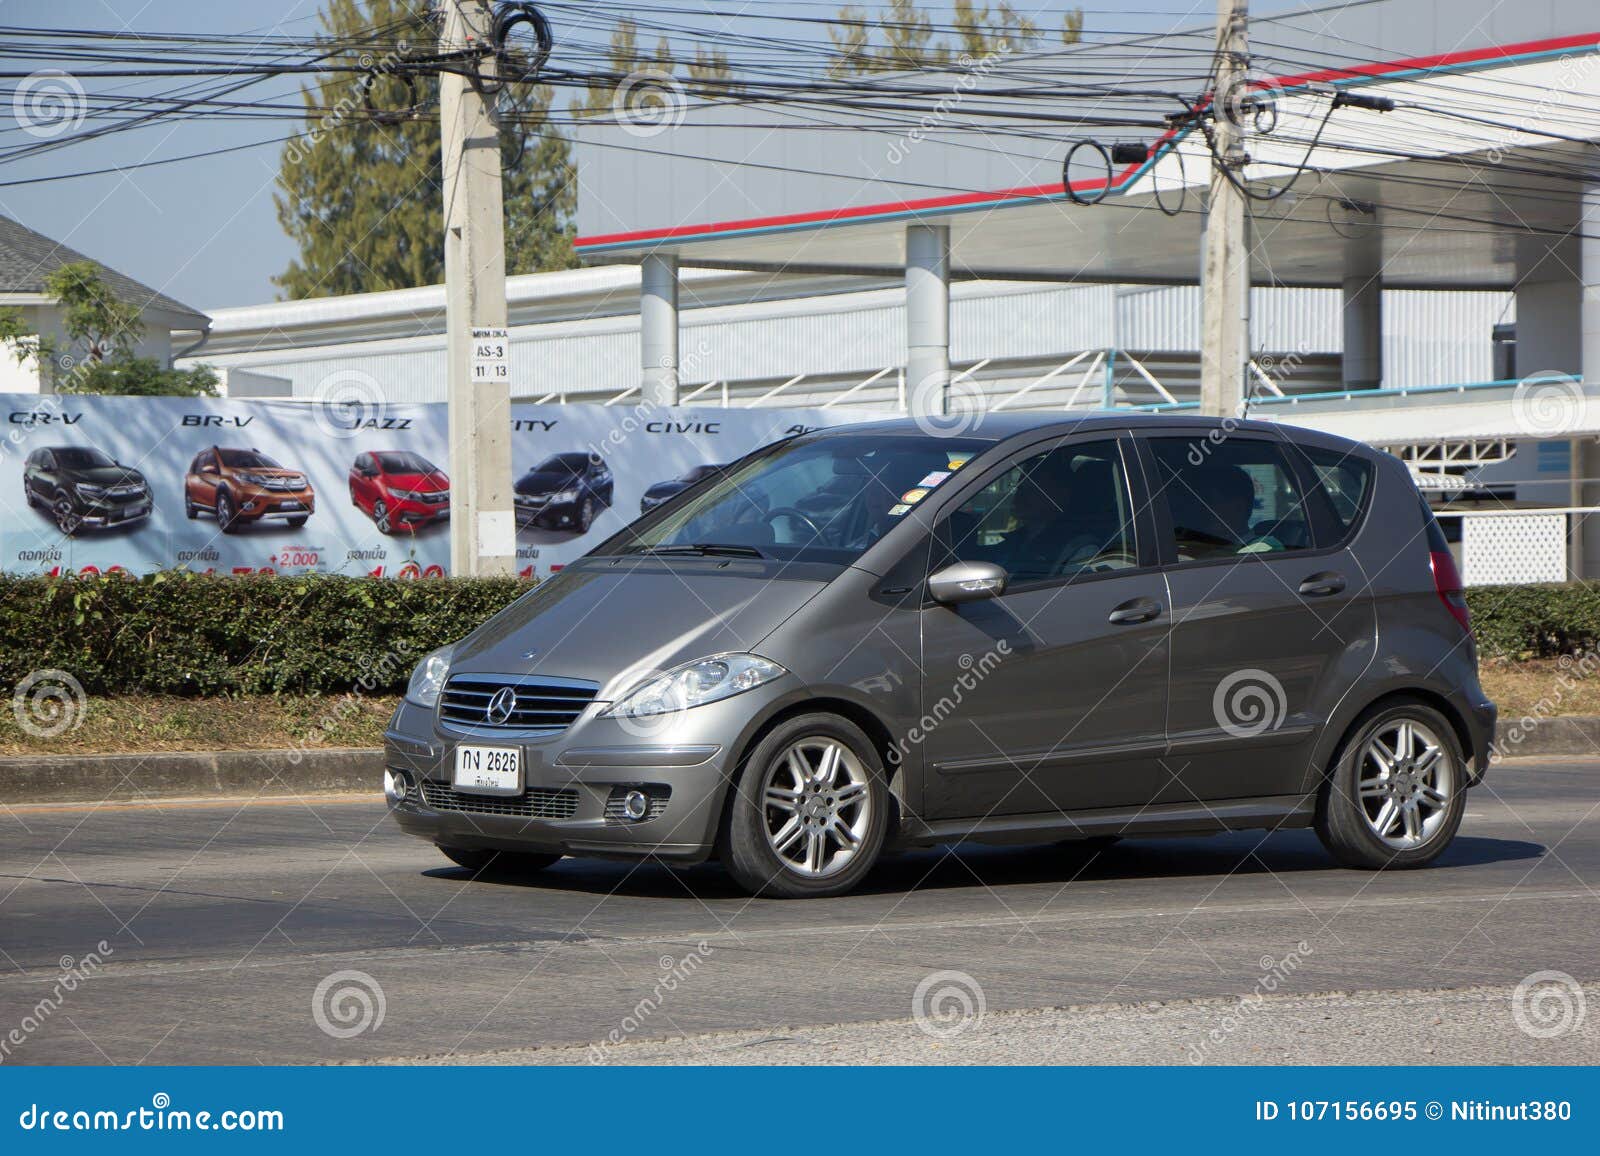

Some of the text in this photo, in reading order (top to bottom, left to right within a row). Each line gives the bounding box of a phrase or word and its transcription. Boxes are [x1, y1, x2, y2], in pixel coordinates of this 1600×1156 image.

[477, 345, 503, 357] AS-3
[9, 412, 83, 425] CR-V
[181, 415, 254, 427] BR-V
[345, 418, 413, 430] JAZZ
[510, 420, 558, 431] ITY
[646, 422, 721, 434] CIVIC
[487, 751, 517, 772] 2626
